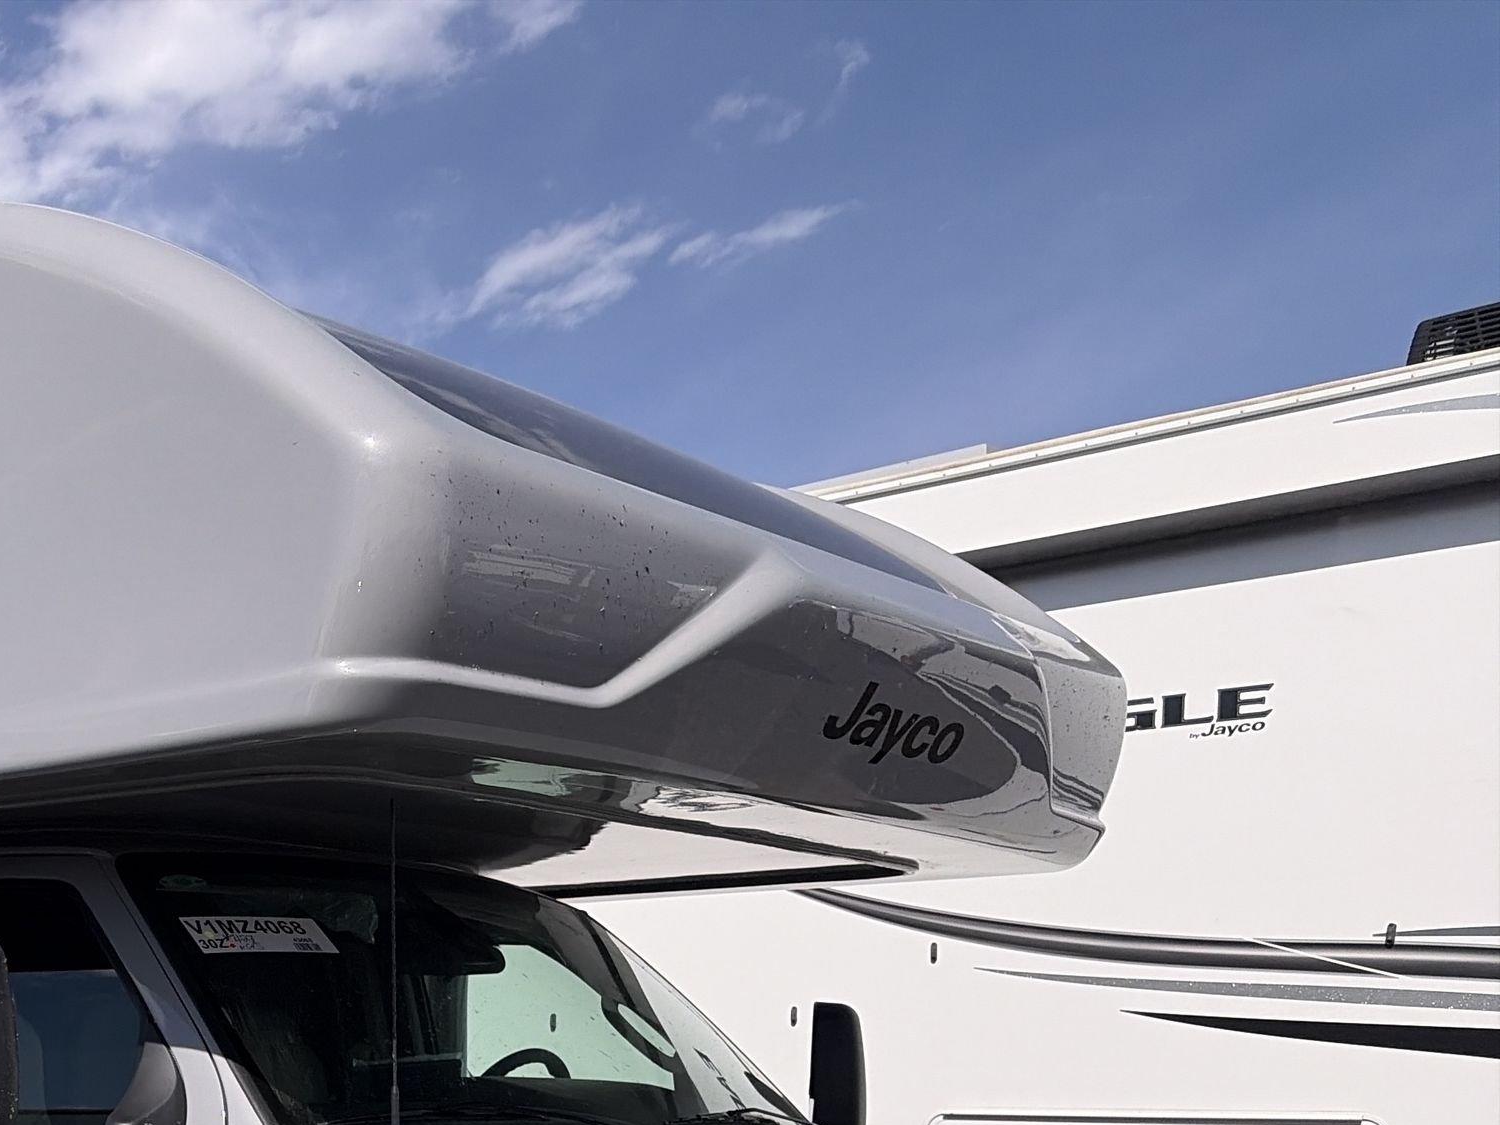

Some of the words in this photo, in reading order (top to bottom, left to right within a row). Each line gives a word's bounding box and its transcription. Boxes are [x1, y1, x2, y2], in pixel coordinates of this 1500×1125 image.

[822, 680, 965, 765] Jayco
[1201, 721, 1266, 737] Jayco
[184, 919, 306, 935] V1MZ4068
